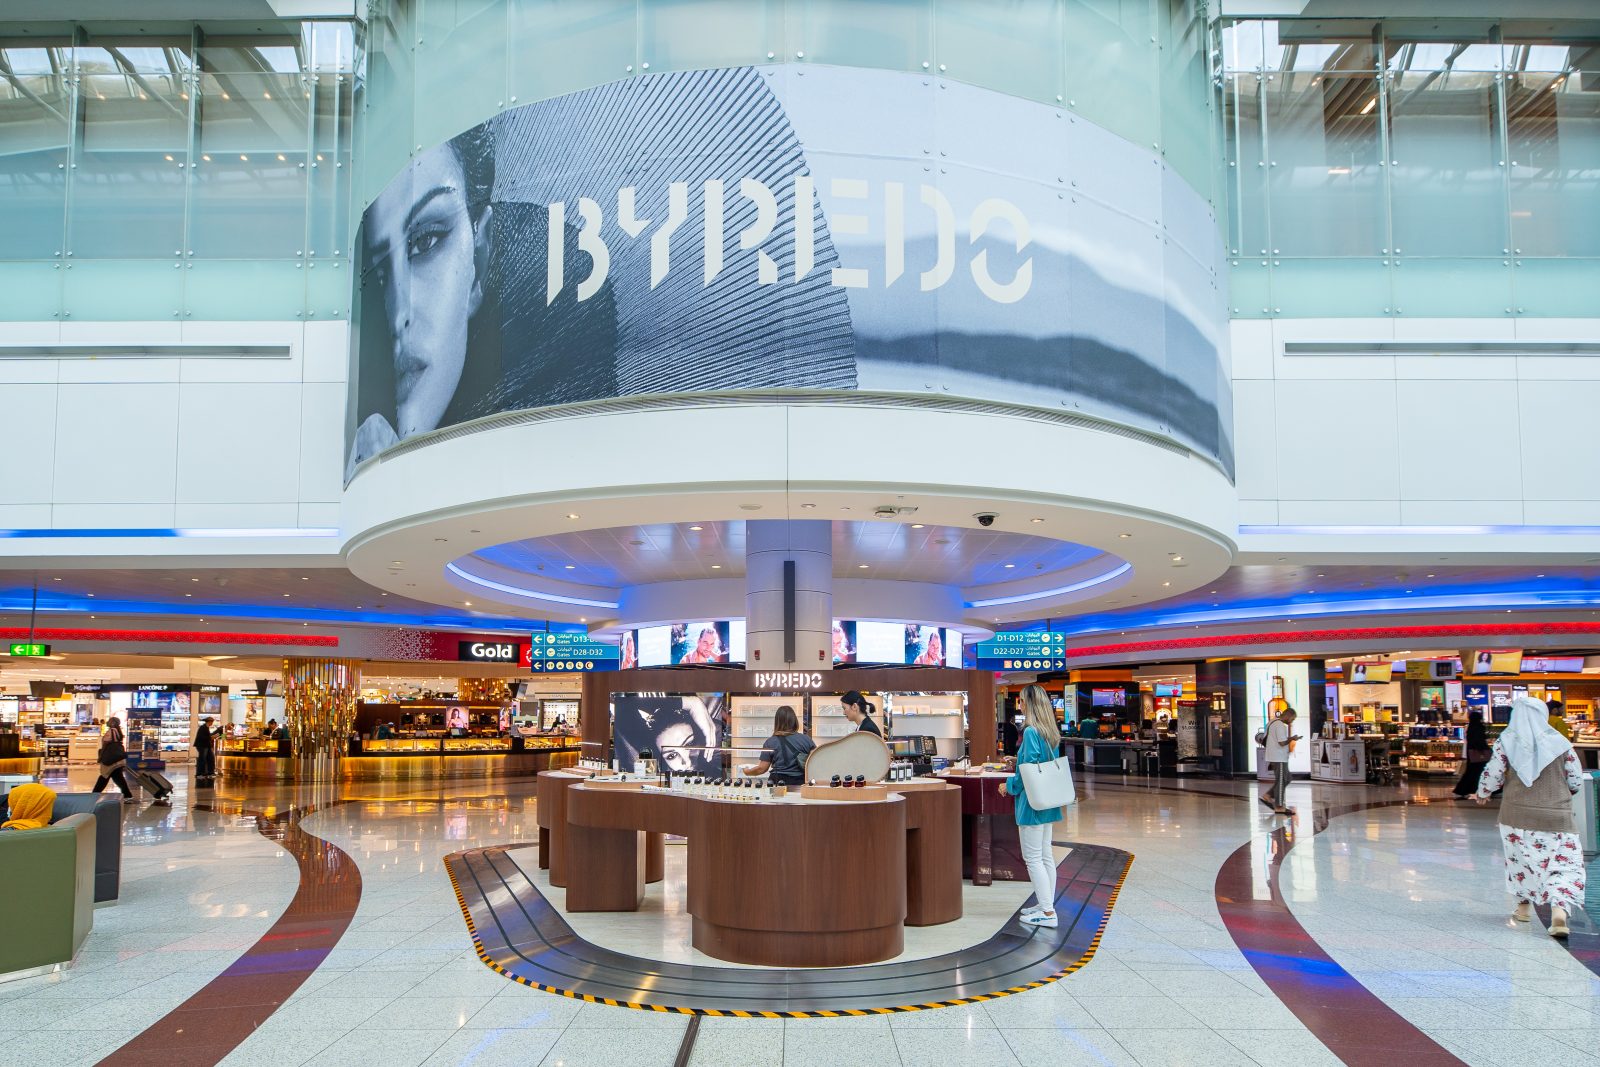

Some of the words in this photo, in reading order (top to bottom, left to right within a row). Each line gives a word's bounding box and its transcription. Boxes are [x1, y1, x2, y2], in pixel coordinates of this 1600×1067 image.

[547, 177, 1033, 307] BYREDO
[471, 643, 513, 658] Gold
[755, 672, 822, 688] BYREDO
